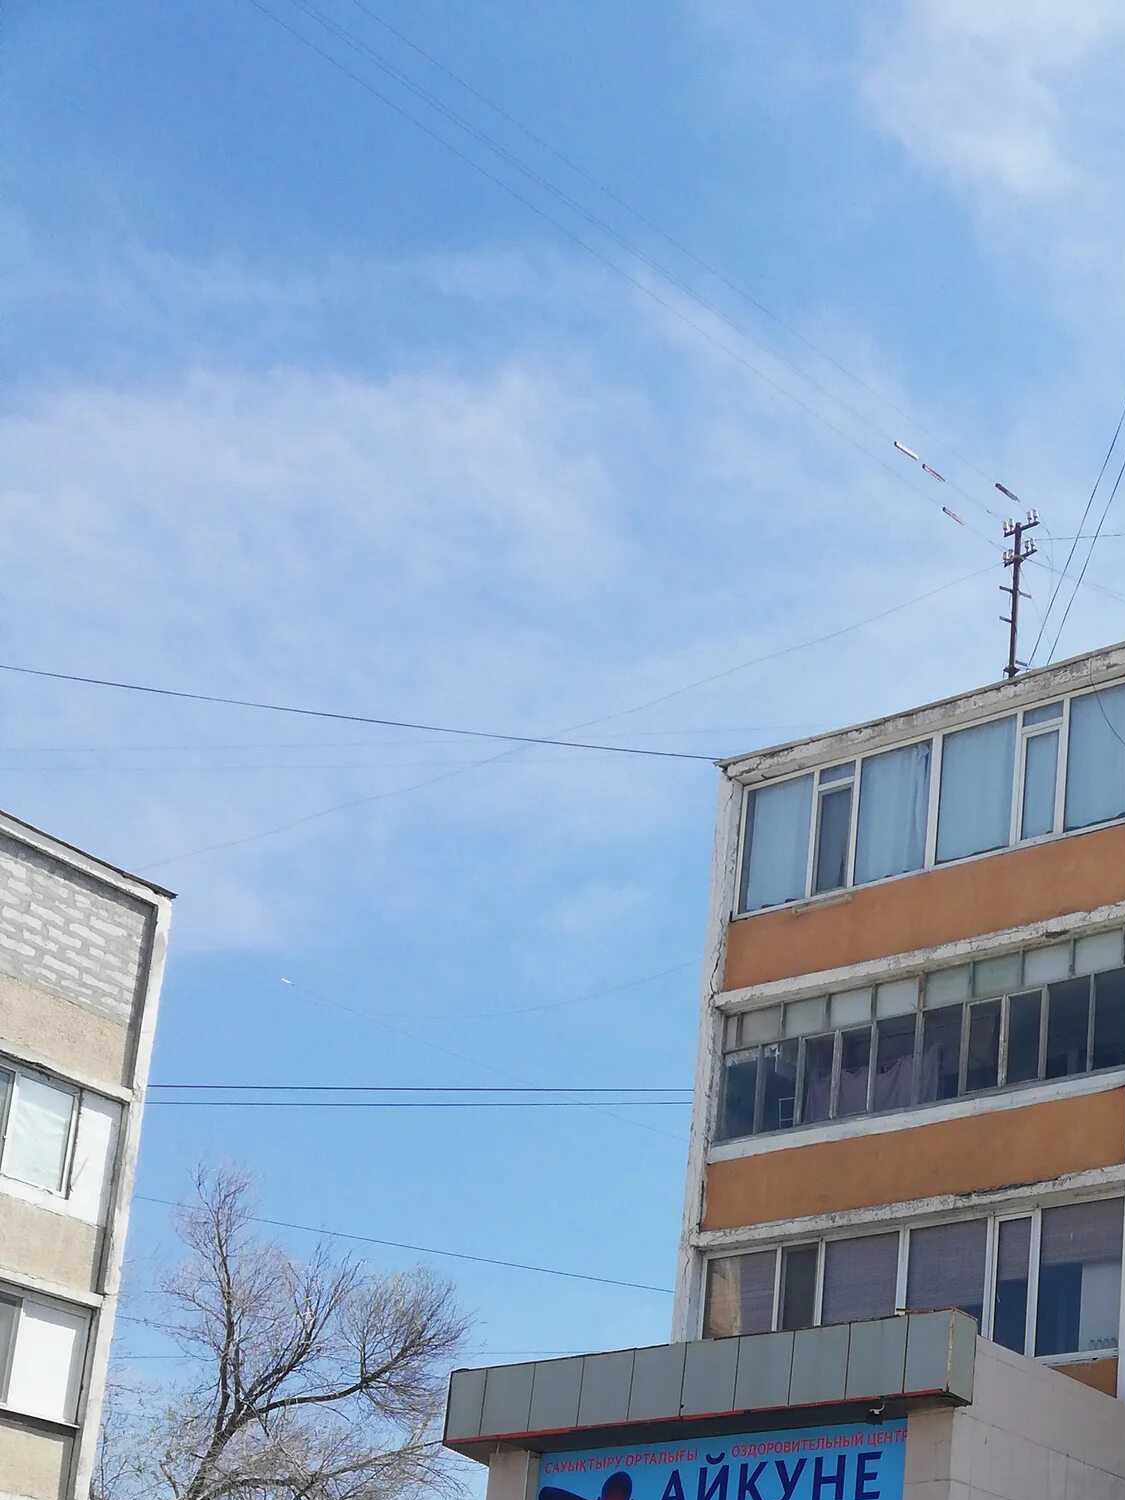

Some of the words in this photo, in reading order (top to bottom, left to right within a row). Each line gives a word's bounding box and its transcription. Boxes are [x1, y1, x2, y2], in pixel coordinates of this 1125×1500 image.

[731, 1431, 863, 1457] ОЗДОРОВИТЕЛЬНЫЙ
[544, 1455, 622, 1474] САУЫҚТЫРУ
[625, 1448, 698, 1467] ОРТАЛЫҒЫ
